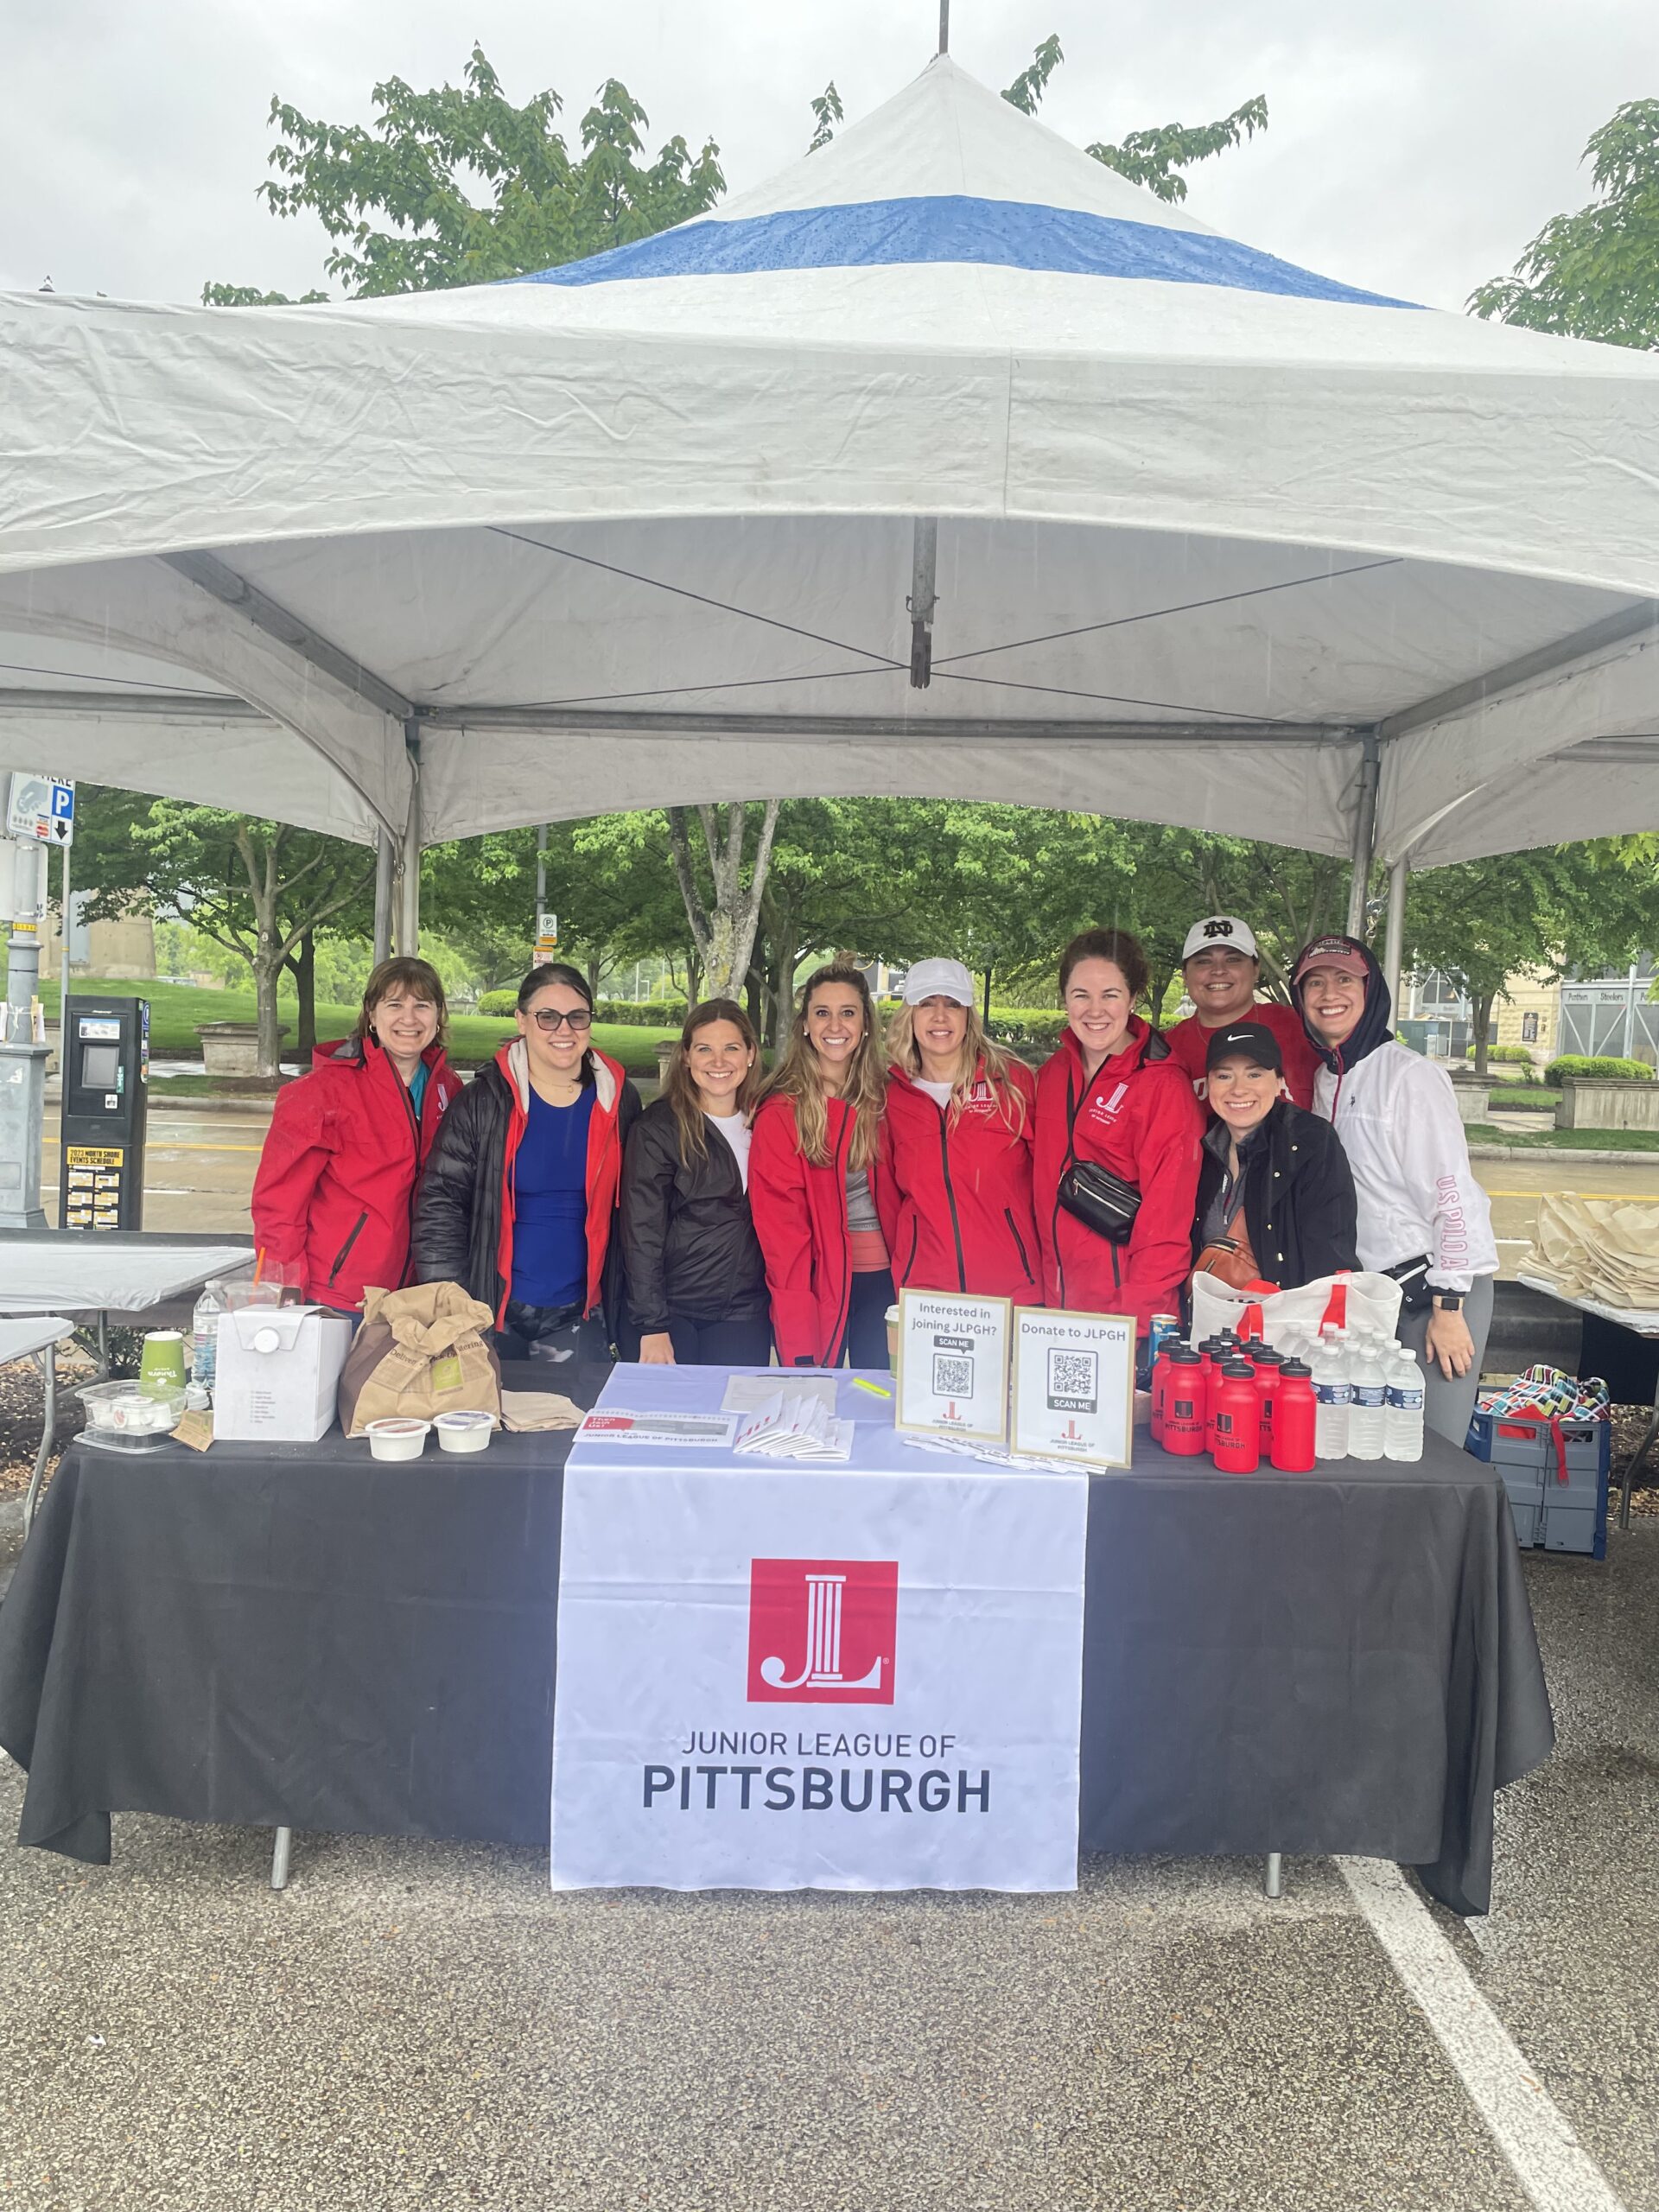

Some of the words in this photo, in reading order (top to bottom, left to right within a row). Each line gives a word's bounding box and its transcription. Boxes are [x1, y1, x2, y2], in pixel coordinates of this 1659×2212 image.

[55, 790, 70, 815] P
[1438, 1207, 1467, 1252] POLO
[919, 1302, 977, 1318] Interested
[980, 1308, 991, 1319] in
[912, 1318, 950, 1334] joining
[952, 1322, 997, 1336] JLPGH?
[1021, 1323, 1065, 1336] Donate
[1068, 1328, 1081, 1338] to
[1084, 1328, 1126, 1342] JLPGH
[938, 1338, 957, 1346] SCAN
[1053, 1399, 1077, 1409] SCAN
[1077, 1402, 1091, 1410] ME
[681, 1731, 788, 1757] JUNIOR
[798, 1732, 912, 1758] LEAGUE
[919, 1735, 957, 1758] OF
[642, 1764, 991, 1814] PITTSBURGH
